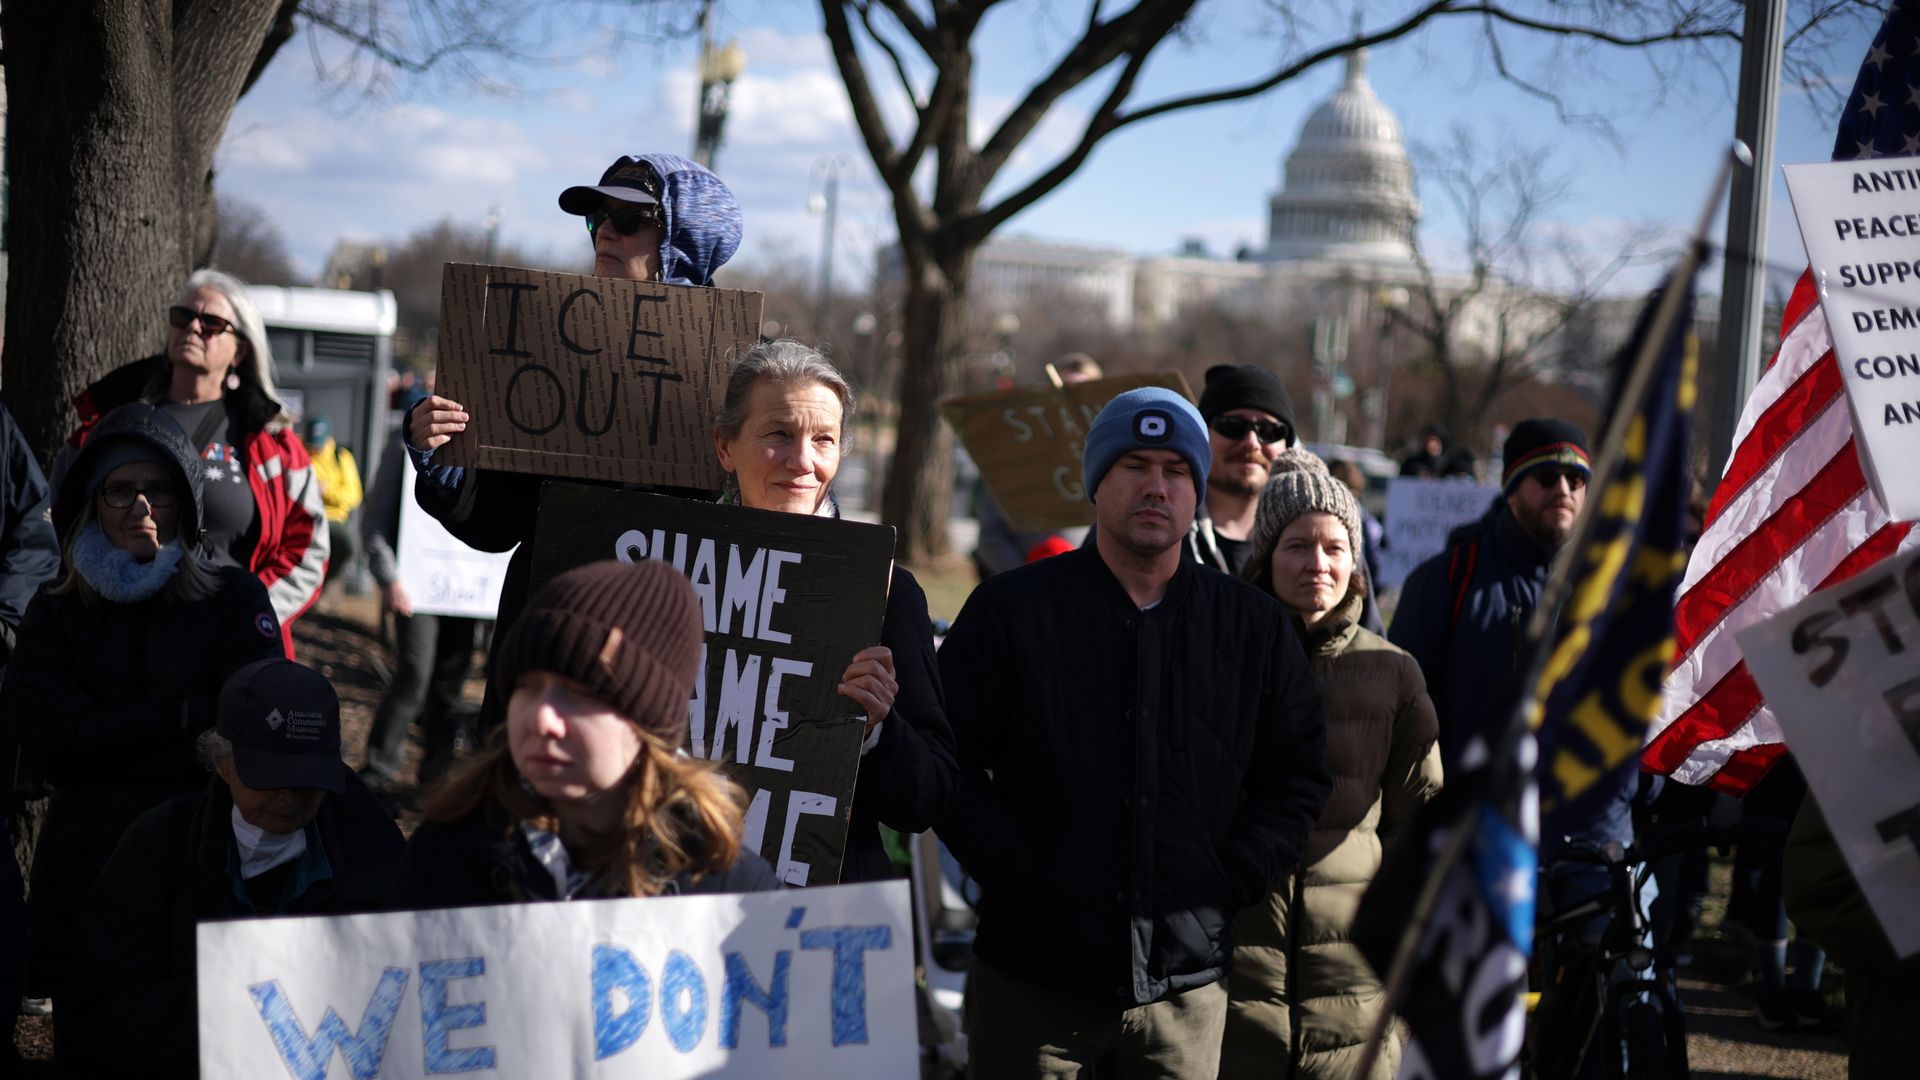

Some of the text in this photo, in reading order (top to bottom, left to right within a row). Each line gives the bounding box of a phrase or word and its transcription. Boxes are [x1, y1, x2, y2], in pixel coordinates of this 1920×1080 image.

[1835, 213, 1920, 241] PEACE
[488, 282, 669, 366] ICE
[1852, 306, 1920, 333] DEM
[506, 362, 684, 446] OUT
[248, 907, 893, 1080] WE DON'T
